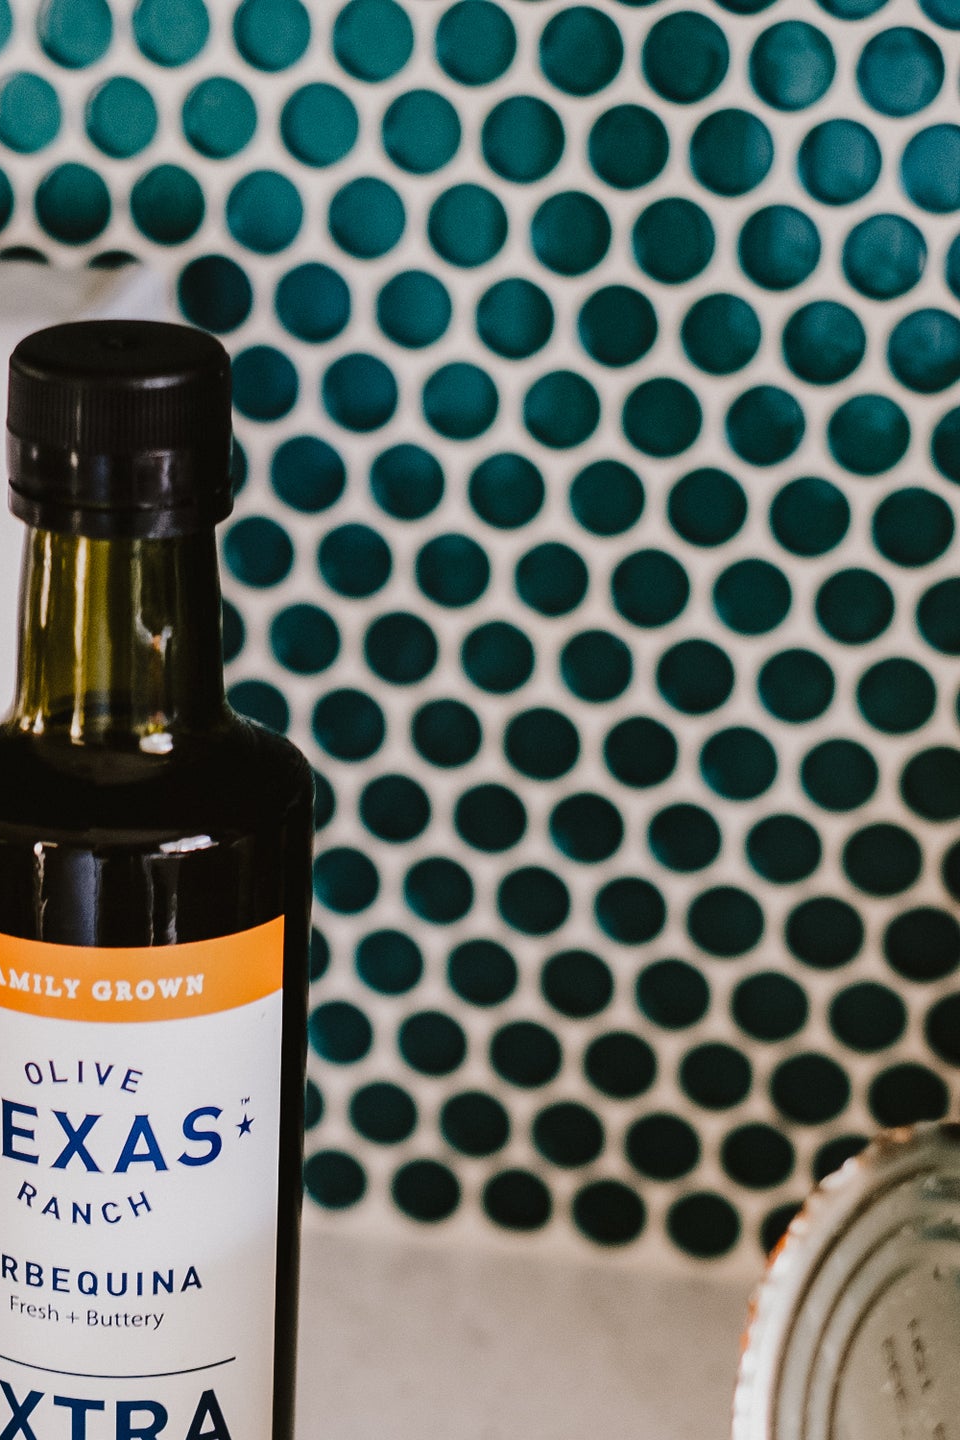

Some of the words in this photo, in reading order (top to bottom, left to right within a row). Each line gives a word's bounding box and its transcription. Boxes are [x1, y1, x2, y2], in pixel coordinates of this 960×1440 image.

[92, 974, 204, 1002] GROWN
[24, 1060, 143, 1094] OLIVE
[17, 1181, 153, 1225] RANCH
[9, 1294, 60, 1322] Fresh
[86, 1308, 165, 1331] Buttery
